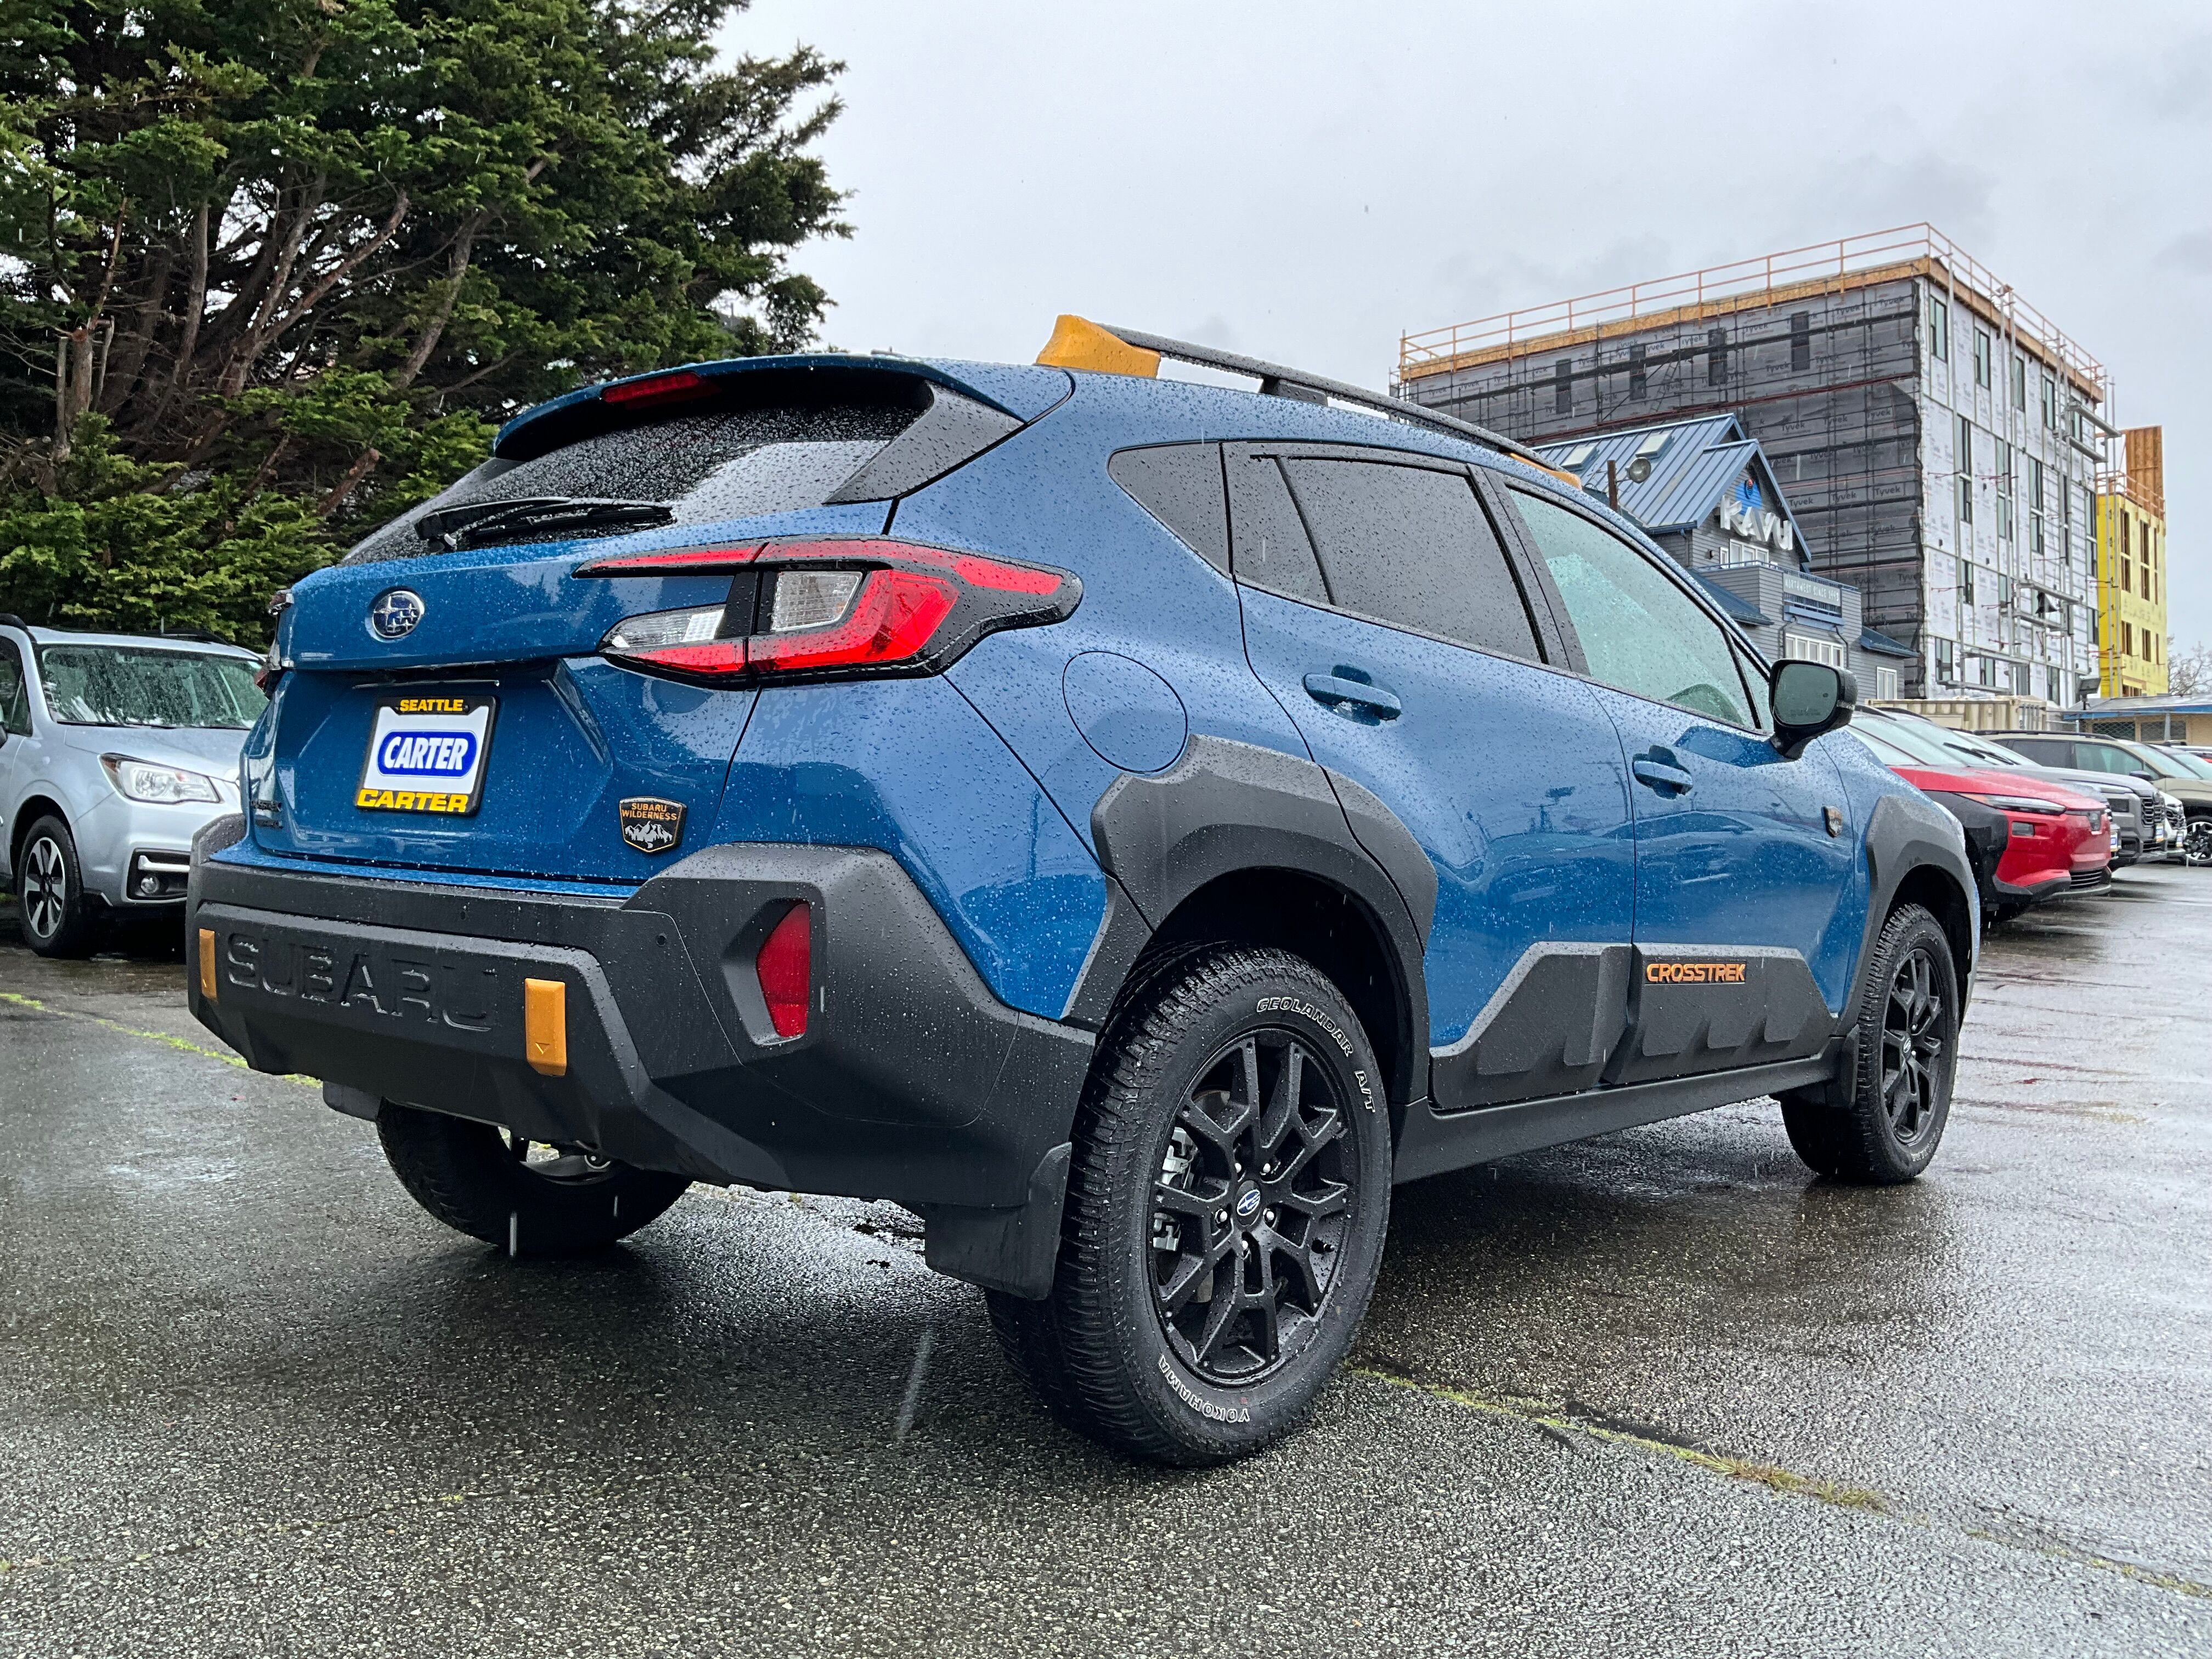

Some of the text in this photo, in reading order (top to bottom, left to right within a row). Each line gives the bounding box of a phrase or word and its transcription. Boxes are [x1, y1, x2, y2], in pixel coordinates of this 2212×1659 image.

[1647, 342, 1664, 353] yvek
[1782, 421, 1804, 433] Tyvek
[1832, 491, 1857, 502] Tyvek
[1875, 486, 1901, 497] Tyvek
[1789, 496, 1813, 507] Tyvek
[1720, 495, 1793, 550] KAVU
[1785, 578, 1811, 593] NORTHWEST
[1813, 585, 1826, 598] SINCE
[399, 699, 464, 712] SEATTLE
[384, 736, 469, 770] CARTER
[357, 789, 468, 812] CARTER
[631, 803, 667, 812] SUBARU
[621, 809, 677, 821] WILDERNESS
[1646, 963, 1746, 982] CROSSTREK
[227, 932, 497, 1032] SUBARU
[1256, 996, 1376, 1113] GEOLANDAR A/T
[1159, 1354, 1250, 1423] YOKOHAMA
